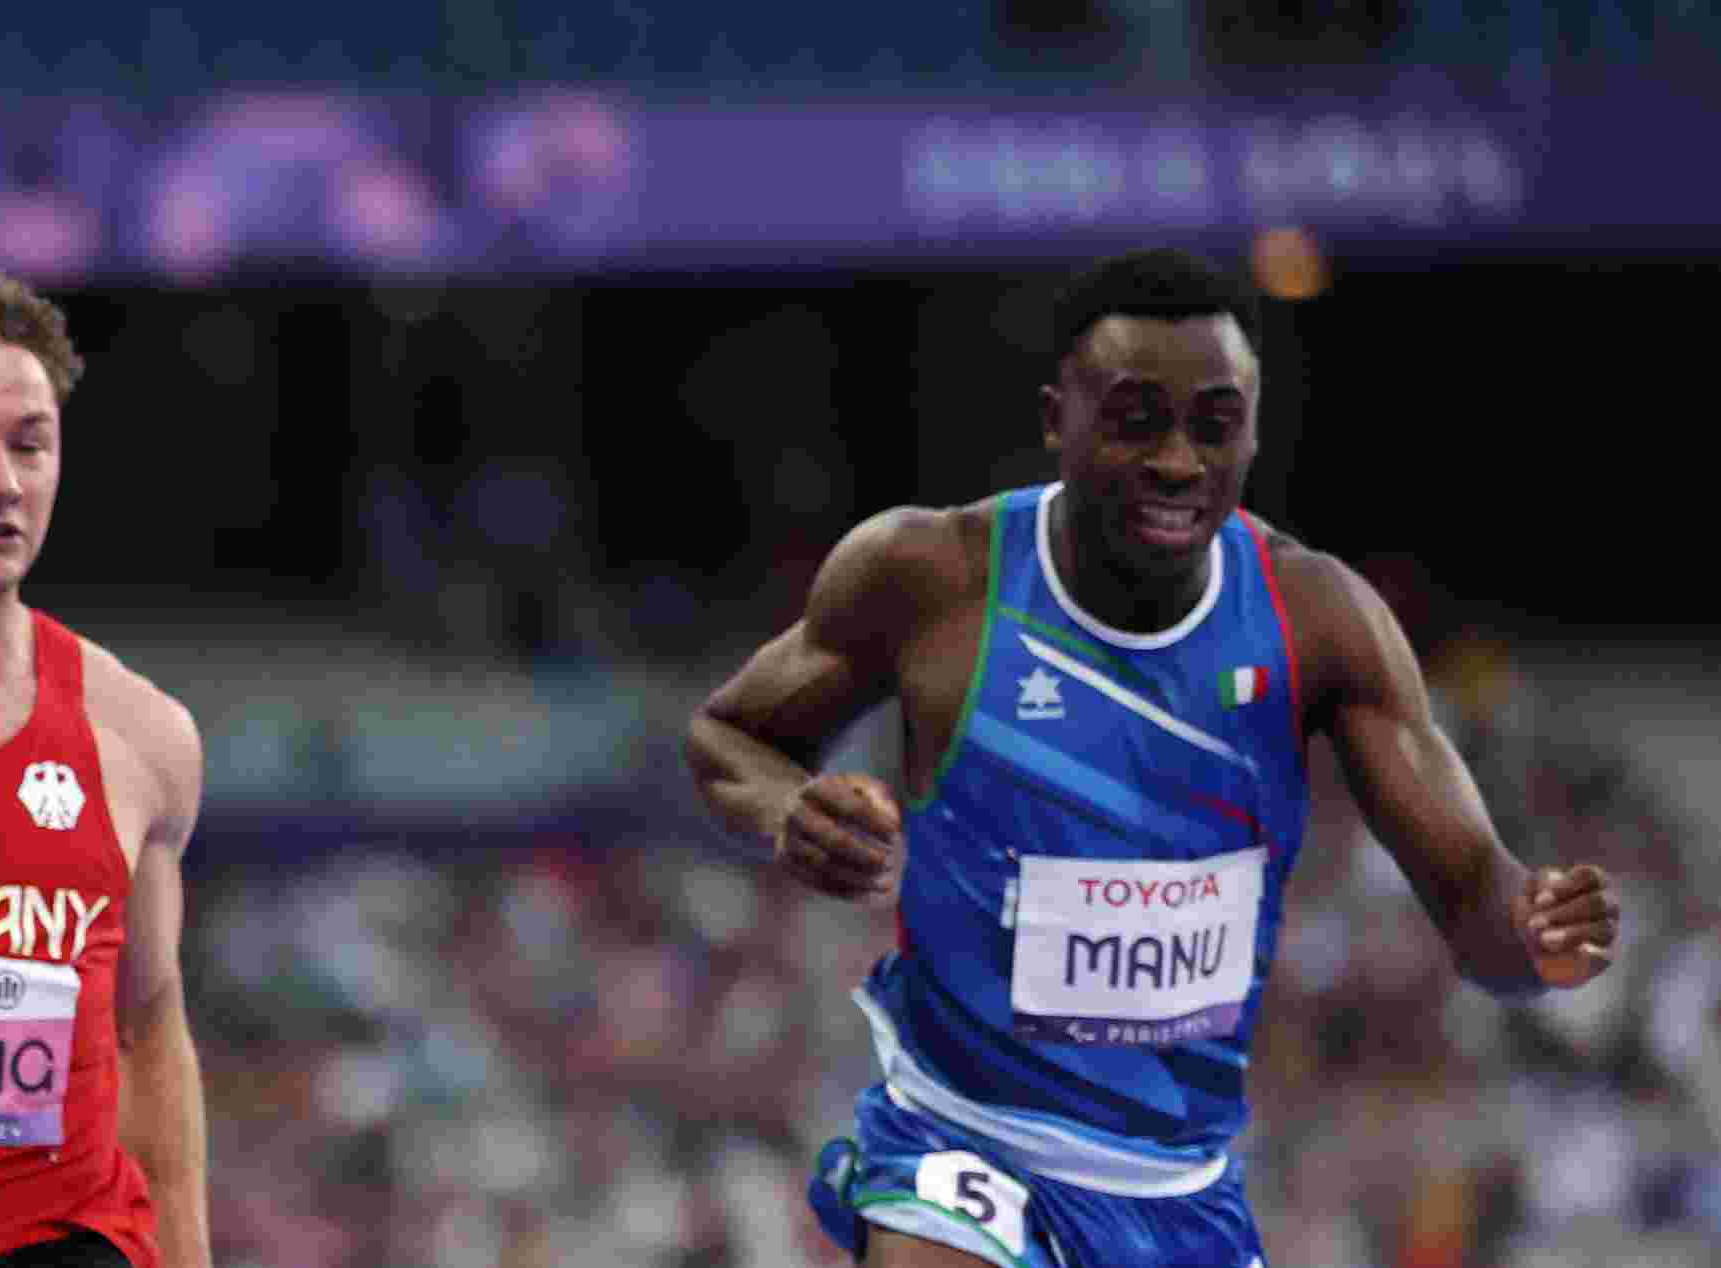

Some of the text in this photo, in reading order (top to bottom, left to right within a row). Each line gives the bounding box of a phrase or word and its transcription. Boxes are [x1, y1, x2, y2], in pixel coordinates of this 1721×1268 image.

[1078, 872, 1220, 910] TOYOTA
[1063, 924, 1227, 991] MANU
[954, 1172, 996, 1223] 5
